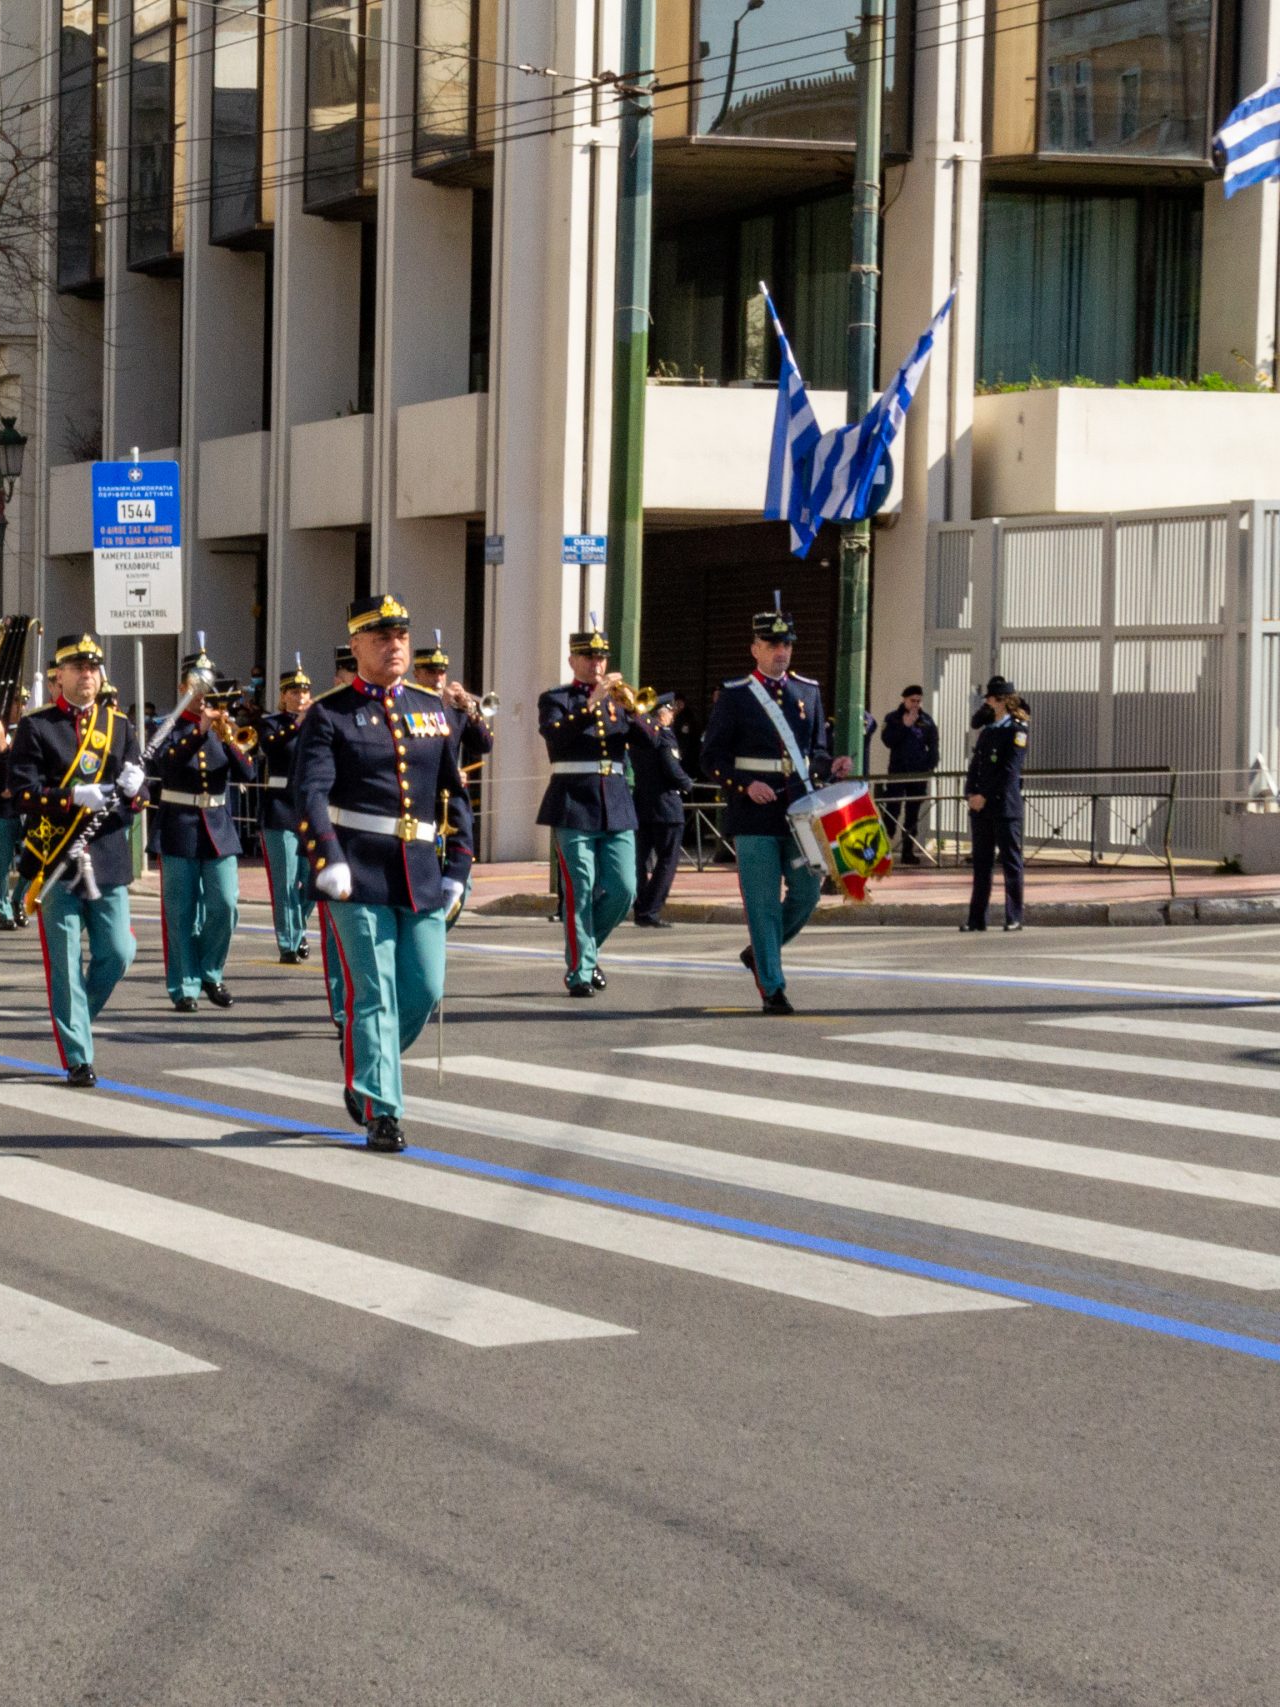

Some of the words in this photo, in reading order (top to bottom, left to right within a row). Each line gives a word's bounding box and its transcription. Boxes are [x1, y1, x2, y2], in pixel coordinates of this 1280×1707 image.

[121, 503, 152, 519] 1544
[101, 551, 131, 560] ΚΑΜΕΡΕΣ
[133, 551, 173, 560] ΔΙΑΧΕΙΡΙΣΗΣ
[115, 562, 160, 571] ΚΥΚΛΟΦΟΡΙΑΣ
[110, 610, 137, 618] TRAFFIC
[138, 609, 168, 618] CONTROL
[123, 620, 155, 629] CAMERAS
